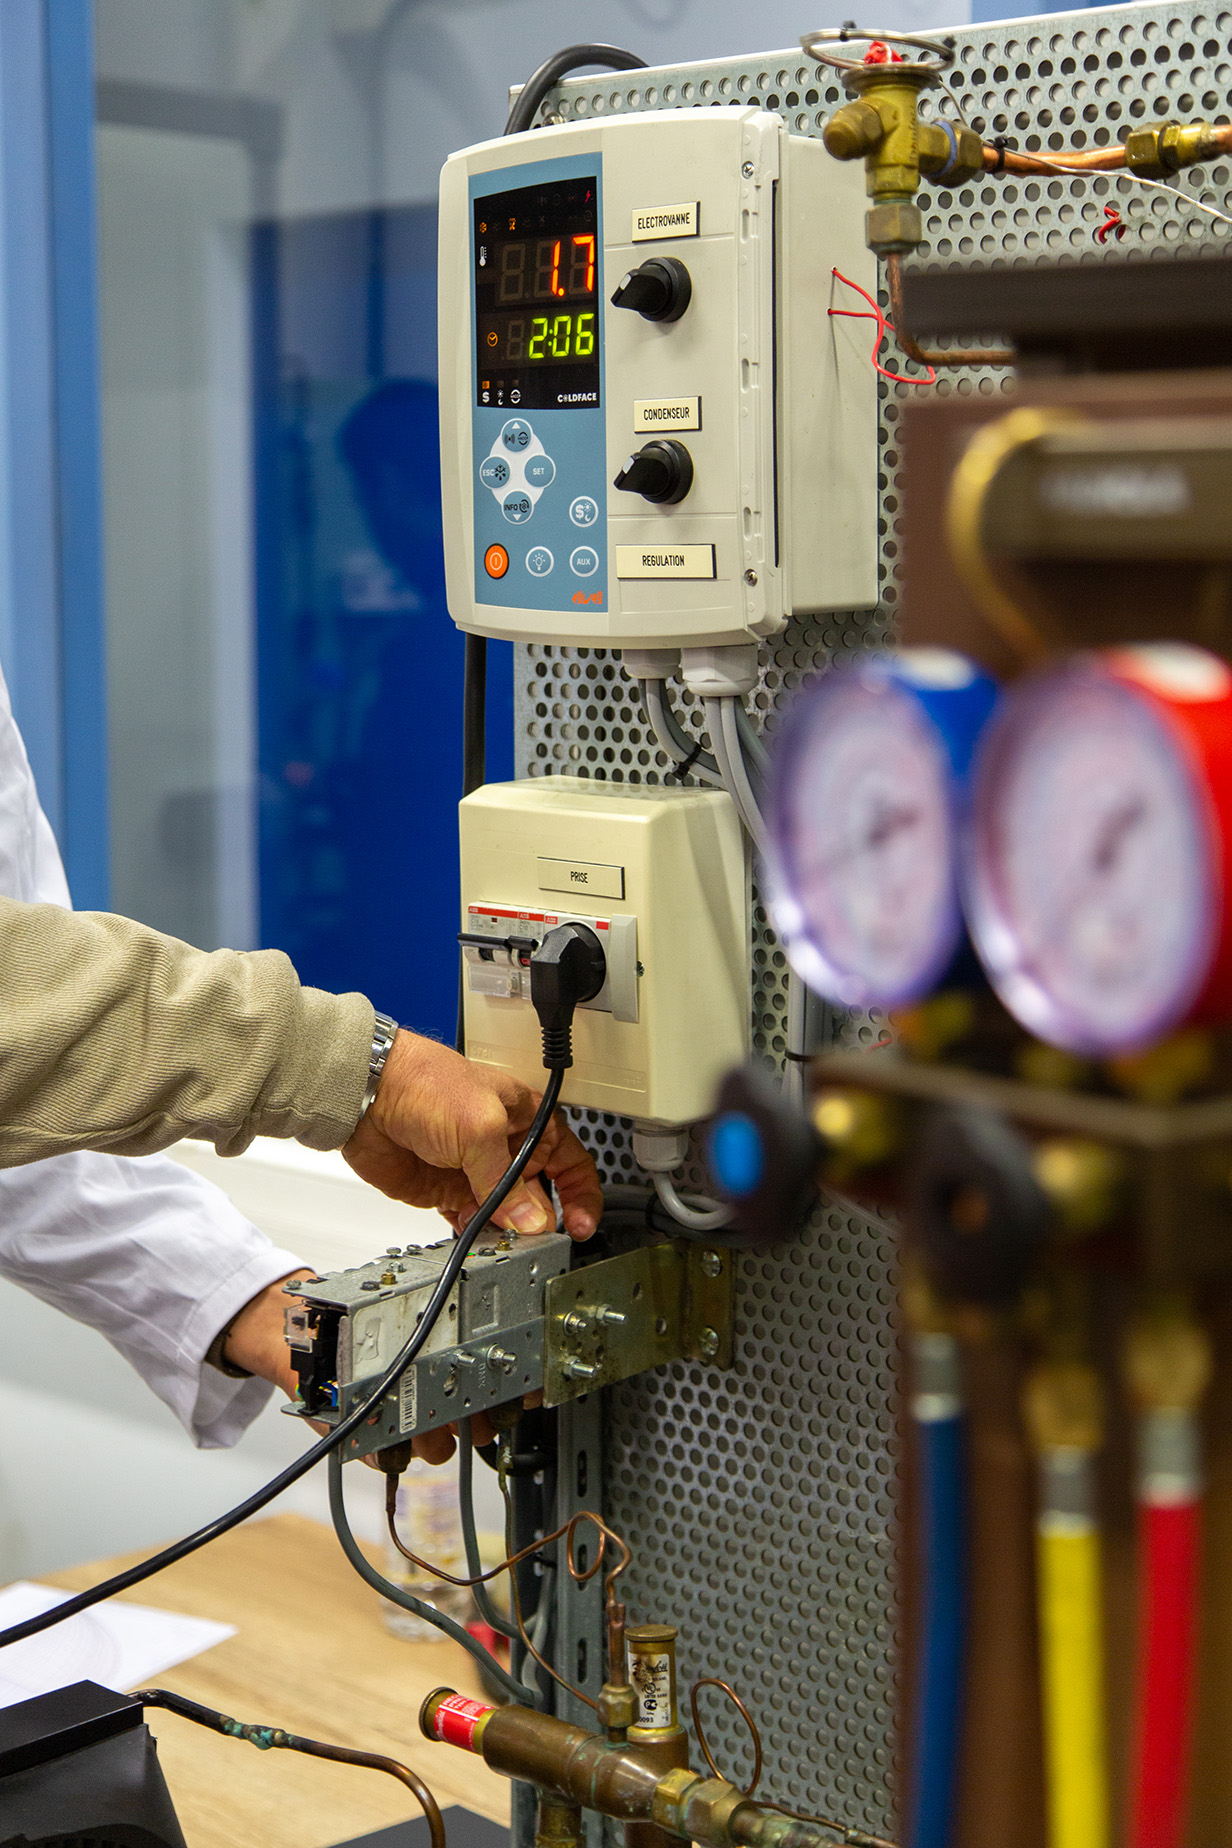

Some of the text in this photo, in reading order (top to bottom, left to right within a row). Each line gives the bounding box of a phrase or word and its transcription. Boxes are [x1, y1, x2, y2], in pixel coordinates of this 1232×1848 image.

[637, 212, 691, 230] ELECTROVANNE
[528, 313, 594, 359] 2:06
[643, 406, 690, 421] CONDENSEUR
[482, 469, 495, 477] ESC
[532, 467, 545, 476] SET
[503, 503, 519, 511] INFO
[576, 558, 591, 566] AUX
[642, 555, 685, 567] REGULATION
[570, 870, 588, 884] PRISE
